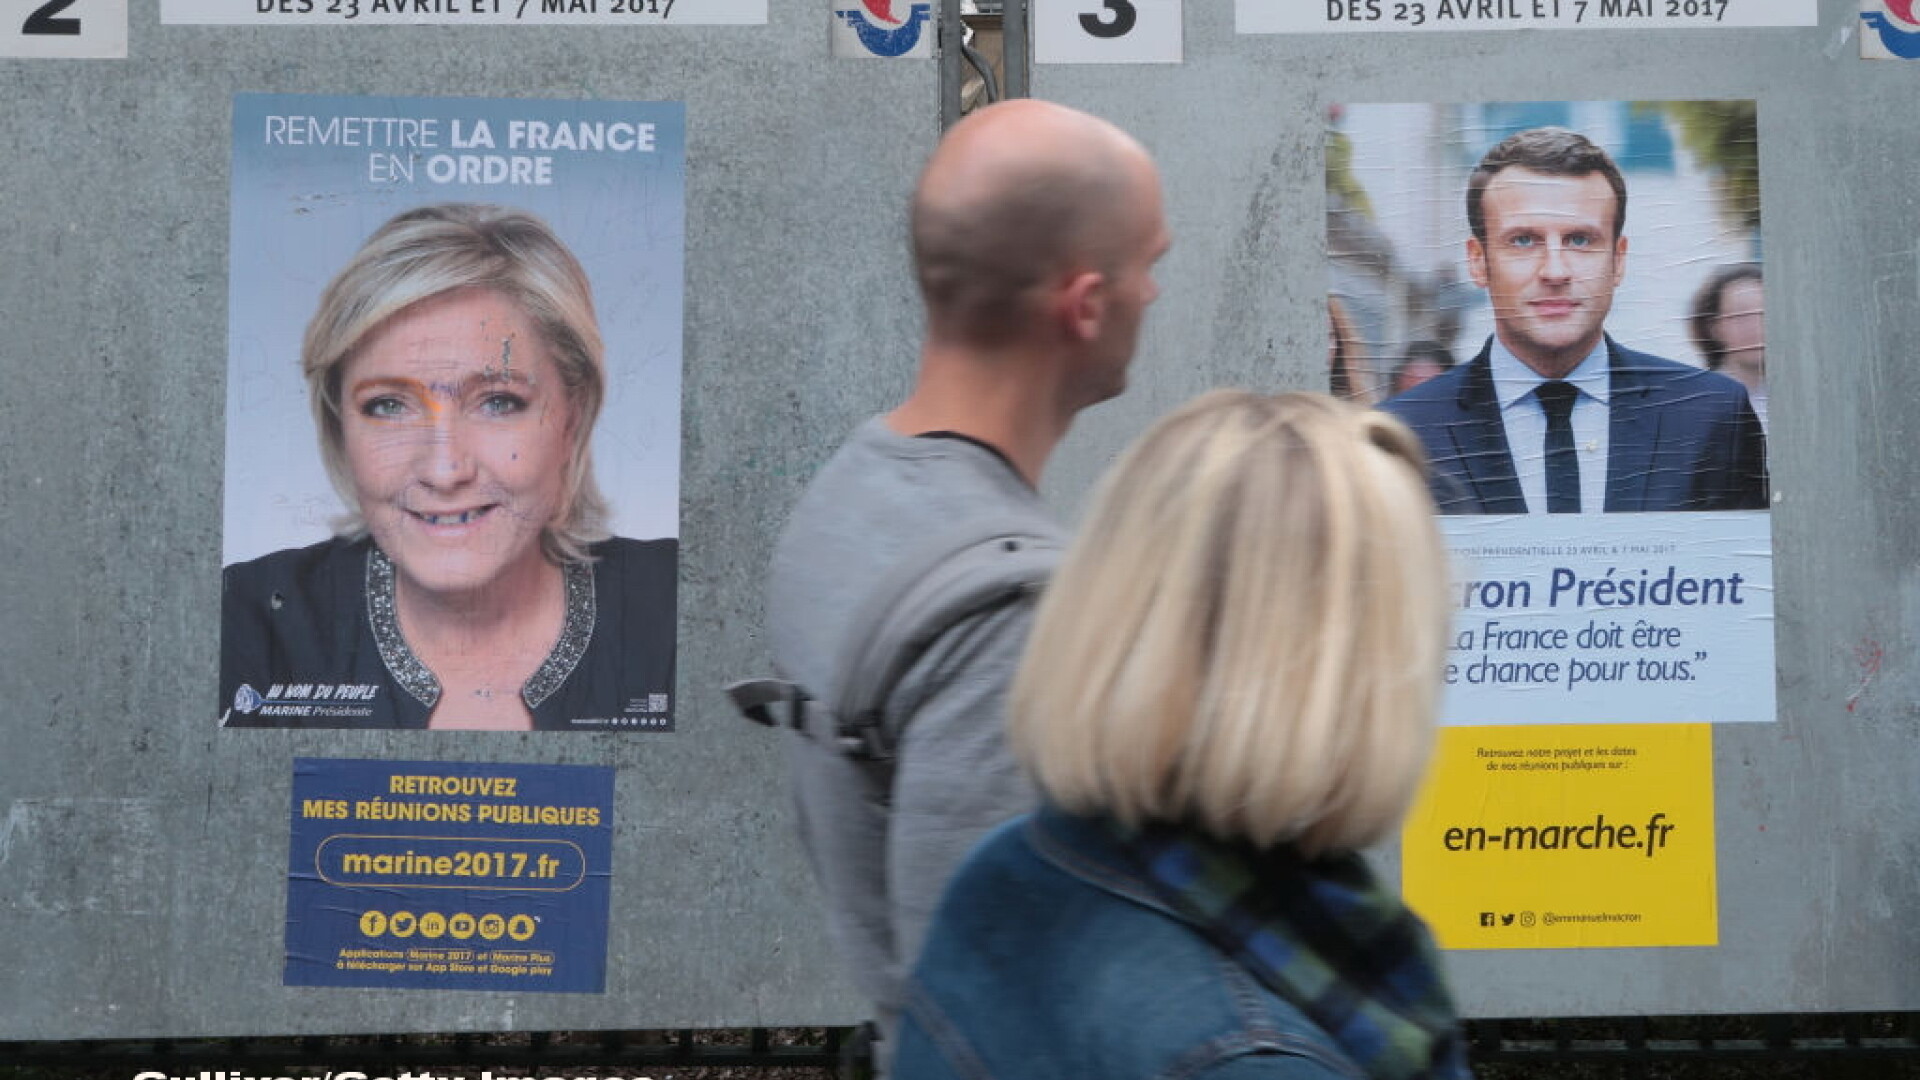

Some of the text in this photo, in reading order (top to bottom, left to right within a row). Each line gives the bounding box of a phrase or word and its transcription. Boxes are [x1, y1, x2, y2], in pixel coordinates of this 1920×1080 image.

[326, 0, 360, 19] 23
[610, 0, 675, 19] 2017
[1078, 0, 1137, 38] 3
[1327, 0, 1382, 21] DES
[1394, 3, 1426, 26] 23
[1437, 0, 1522, 19] AVRIL
[1574, 1, 1588, 23] 7
[1600, 0, 1653, 17] MAI
[1666, 0, 1729, 22] 2017
[265, 115, 656, 152] REMETTRE LA FRANCE
[369, 153, 553, 185] EN ORDRE
[1549, 565, 1745, 608] Président
[1483, 621, 1568, 650] France
[1576, 620, 1624, 649] doit
[1632, 620, 1681, 648] être
[1466, 654, 1560, 684] chance
[1567, 657, 1628, 691] pour
[259, 705, 311, 717] MARINE
[390, 775, 517, 797] RETROUVEZ
[303, 796, 600, 826] MES RÉUNIONS PUBLIQUES
[1444, 813, 1674, 857] en-marche.fr
[342, 850, 560, 878] marine2017.fr
